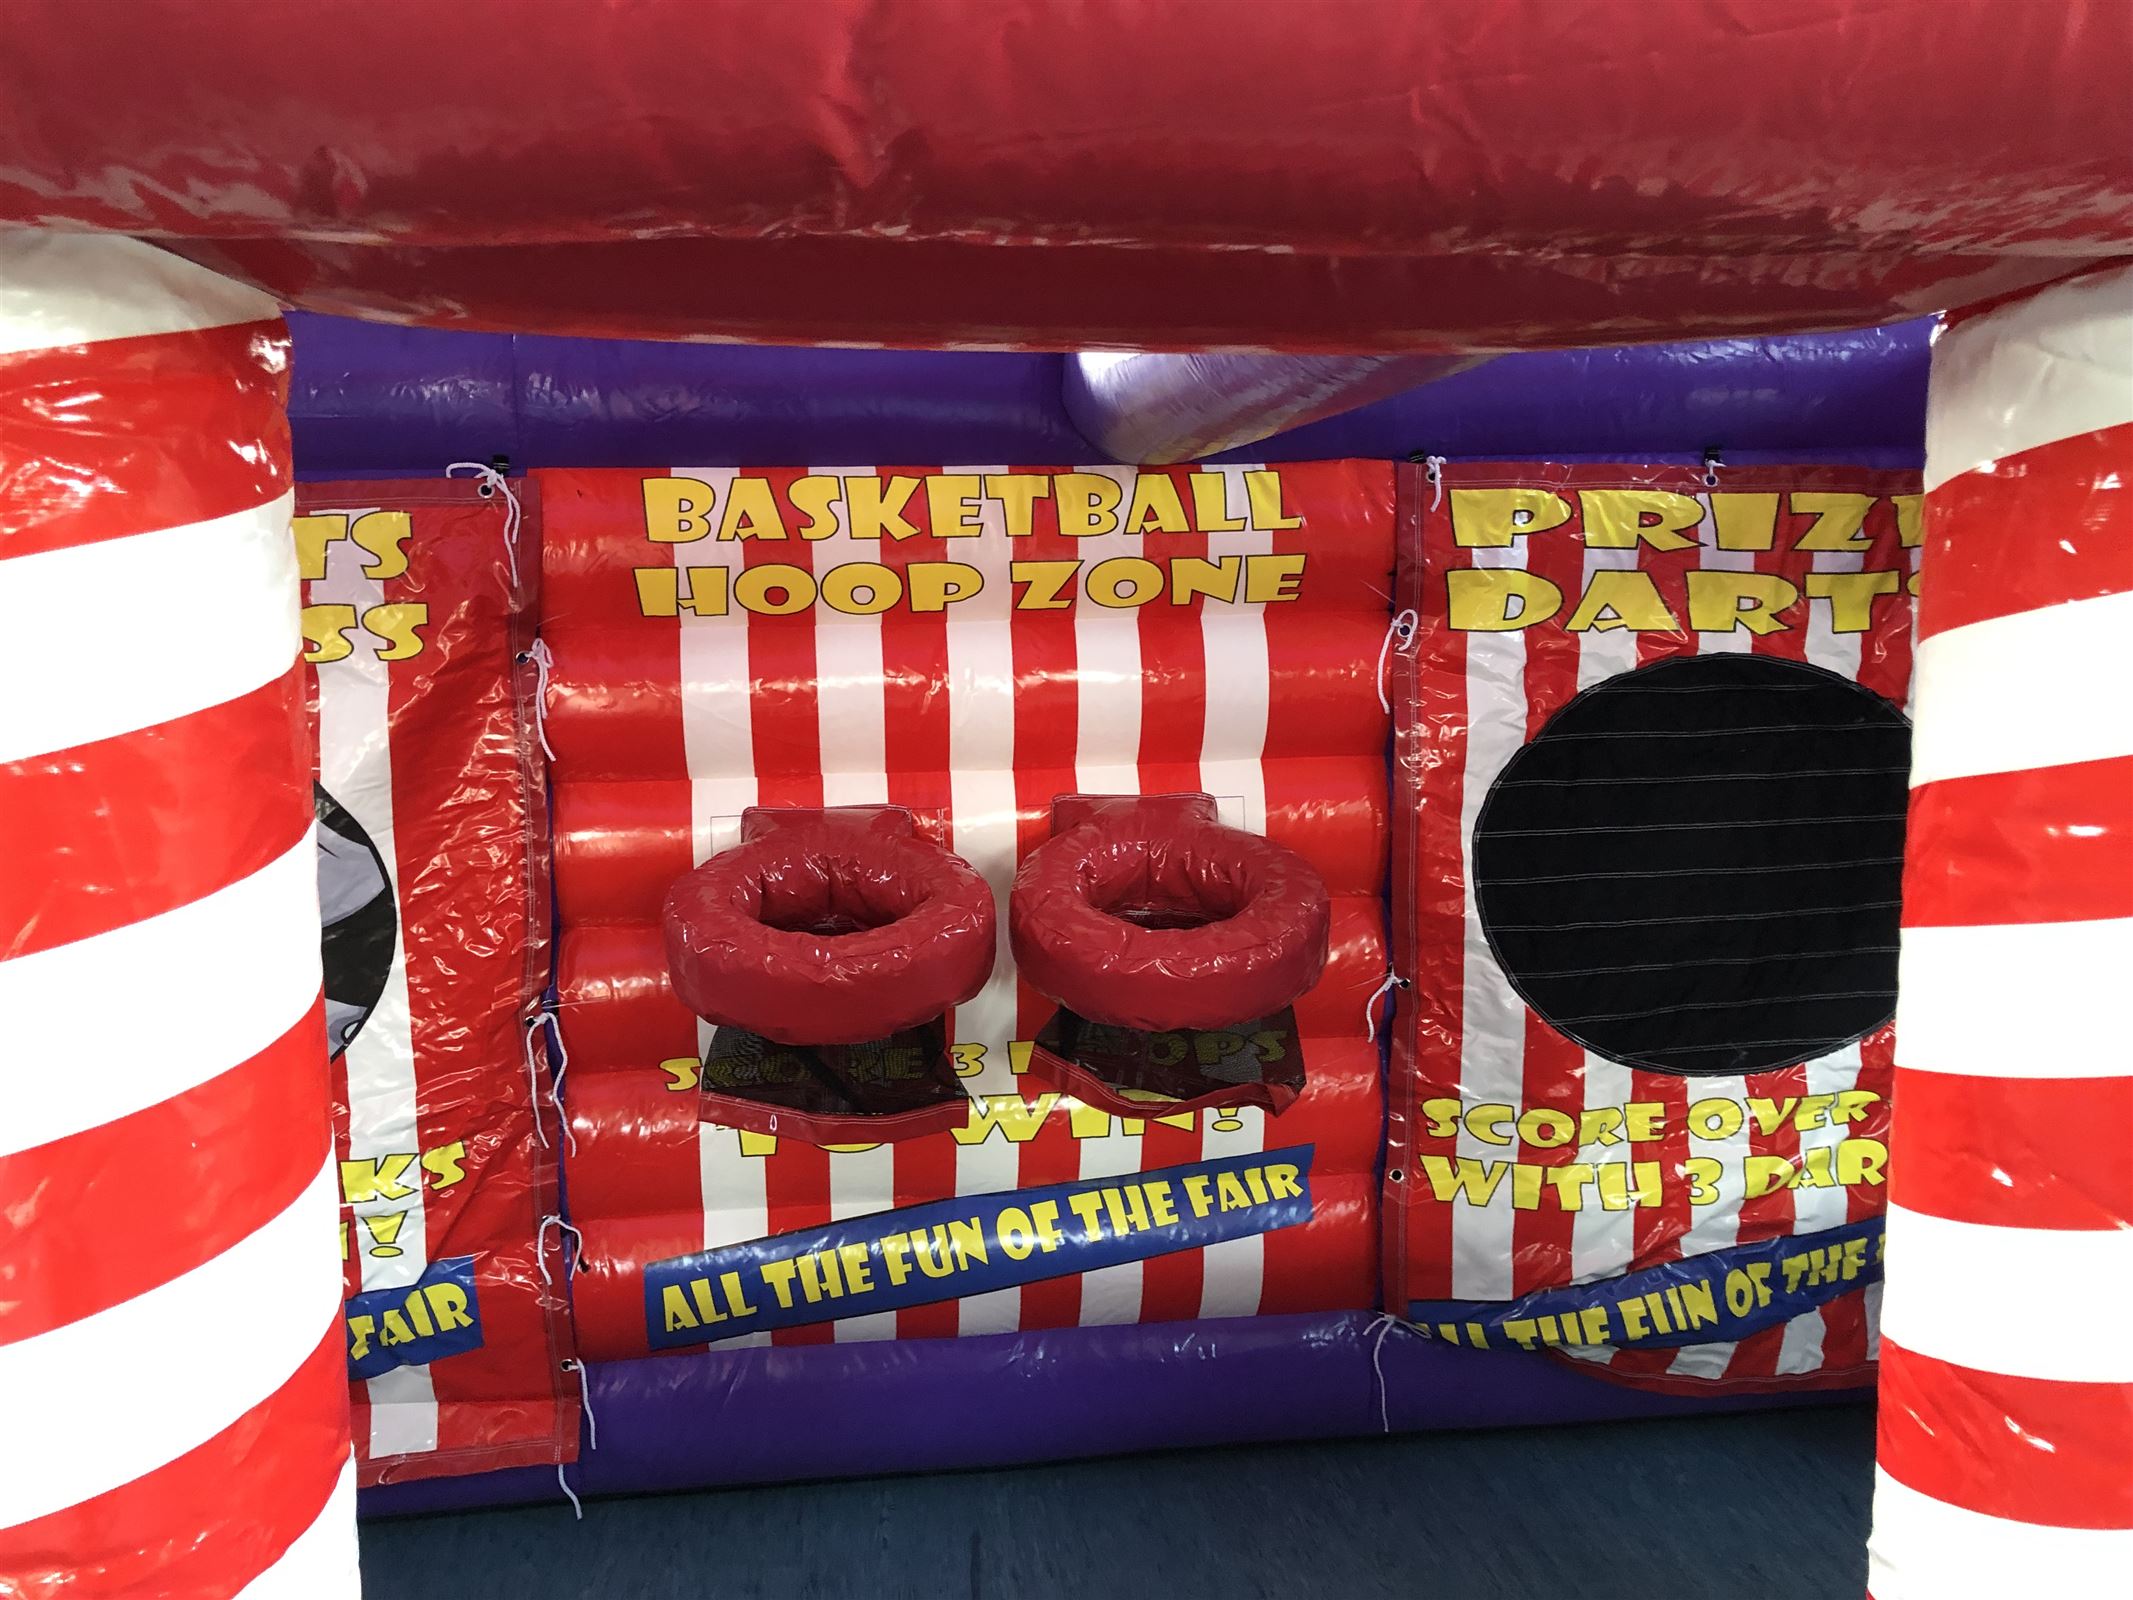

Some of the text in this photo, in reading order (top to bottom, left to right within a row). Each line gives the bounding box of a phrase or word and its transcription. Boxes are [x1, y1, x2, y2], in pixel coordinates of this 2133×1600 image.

[641, 471, 1301, 543] BASKETBALL
[632, 553, 1307, 617] HOOP ZONE
[1446, 568, 1919, 635] DART
[950, 1042, 988, 1077] 3
[1421, 1089, 1882, 1148] SCORE OVER
[1419, 1154, 1663, 1212] WITH
[1684, 1156, 1723, 1206] 3
[662, 1162, 1305, 1333] ALL THE FUN OF THE FAIR
[1725, 1262, 1774, 1319] OF
